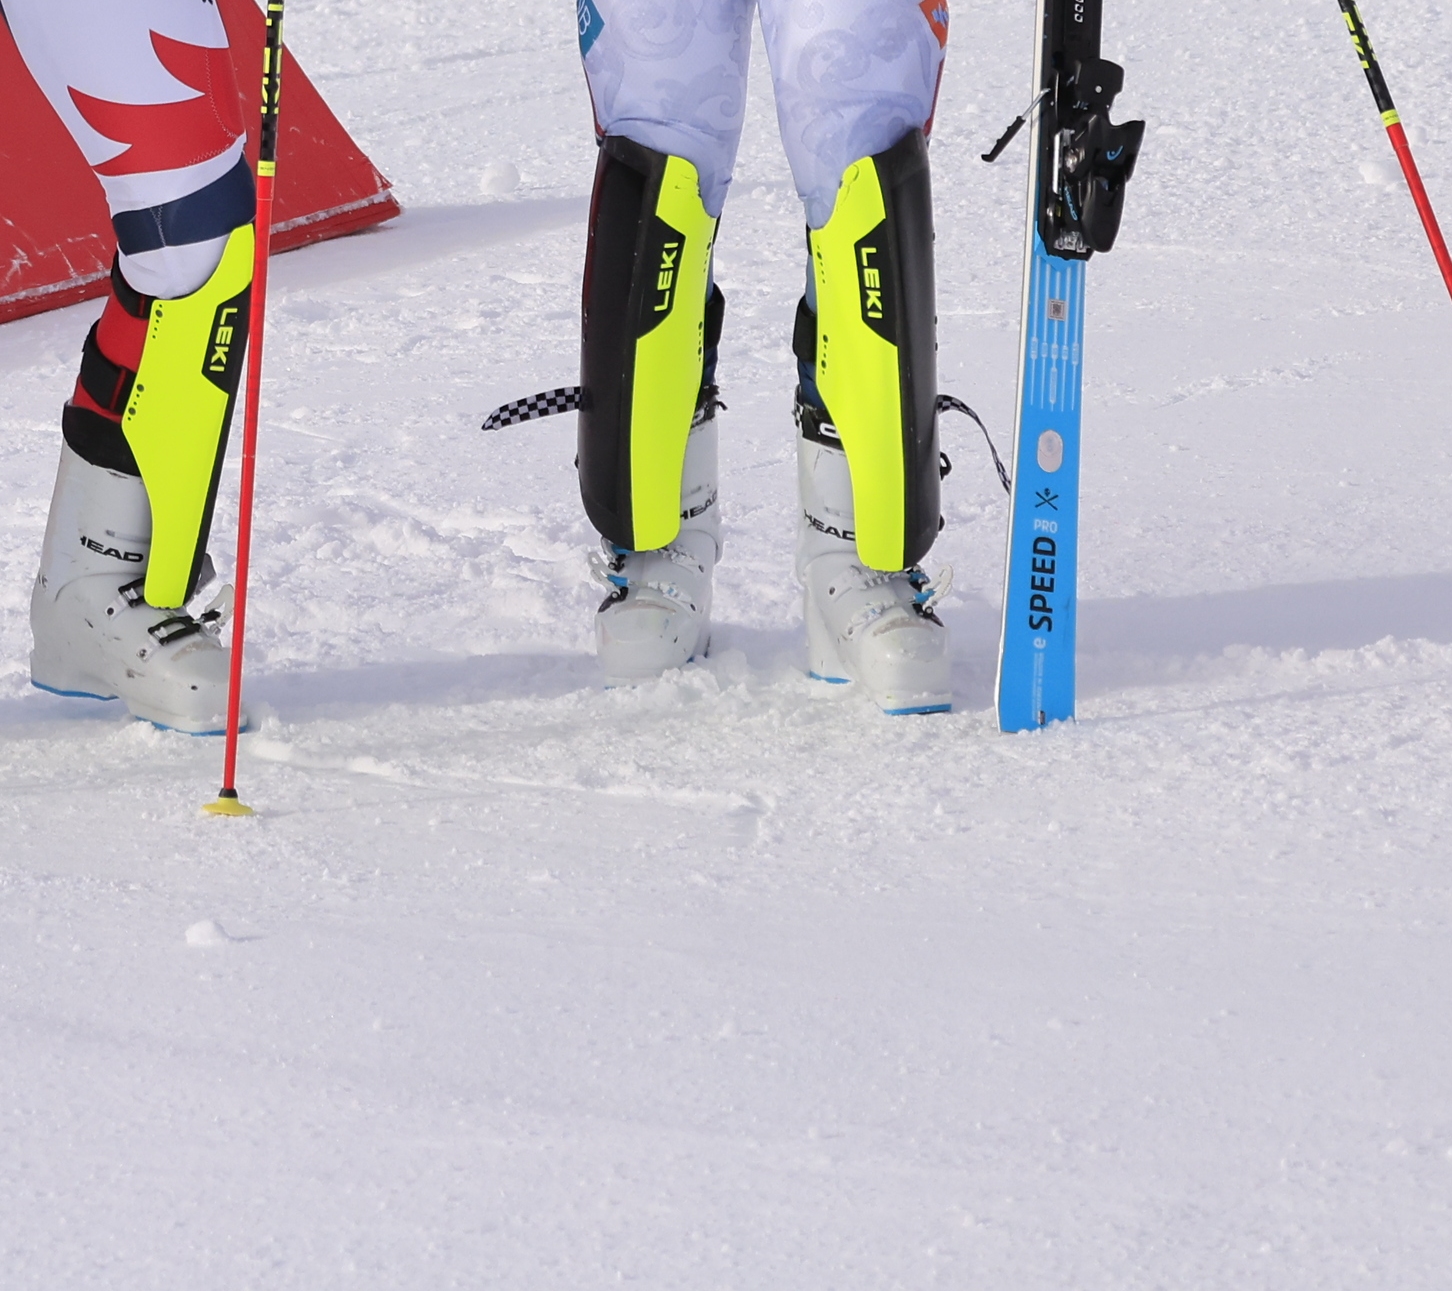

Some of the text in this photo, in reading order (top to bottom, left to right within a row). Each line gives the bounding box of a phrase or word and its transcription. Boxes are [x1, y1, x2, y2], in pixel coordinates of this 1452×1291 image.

[653, 241, 679, 312] LEKI
[861, 247, 884, 319] LEKI
[208, 307, 239, 373] LEKI
[1033, 519, 1059, 533] PRO
[1029, 536, 1057, 632] SPEED
